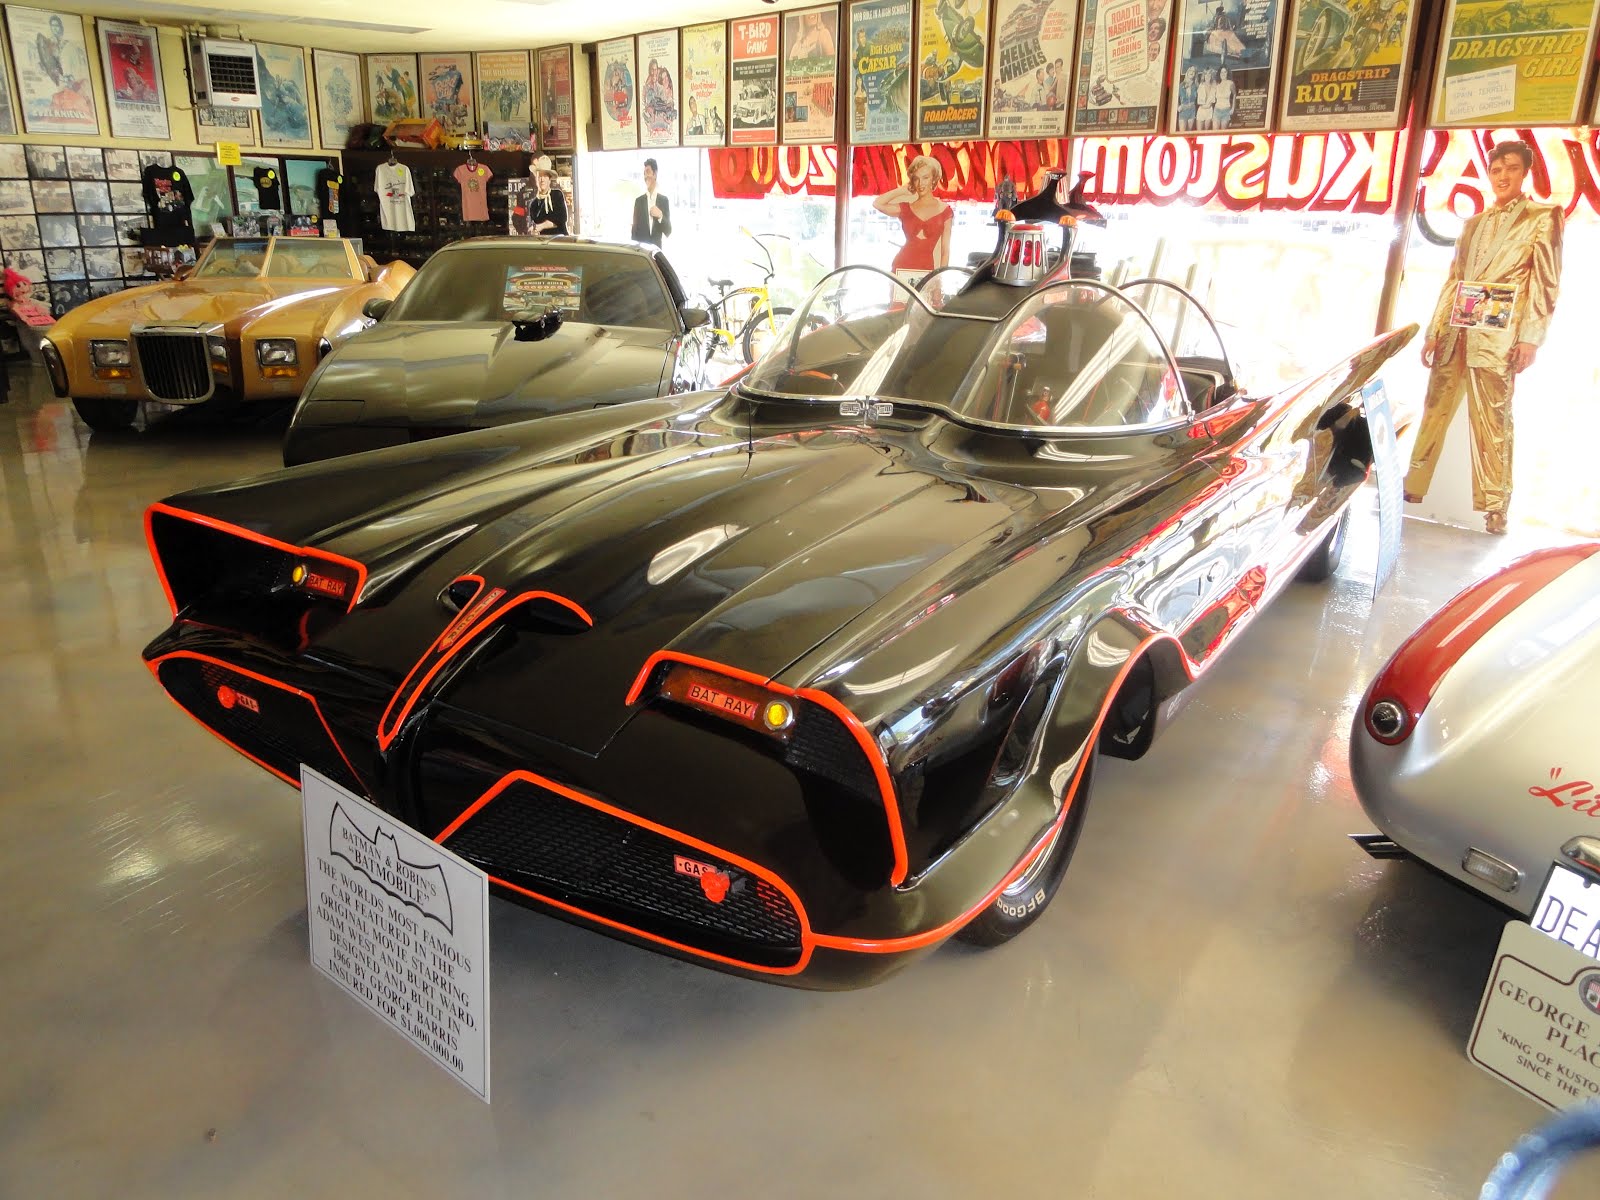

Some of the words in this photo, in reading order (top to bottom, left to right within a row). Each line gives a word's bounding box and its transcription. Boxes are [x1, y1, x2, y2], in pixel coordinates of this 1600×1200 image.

[1108, 14, 1145, 38] NASHVILLE
[1111, 6, 1131, 24] ROAD
[1132, 4, 1141, 15] TO
[746, 40, 768, 54] GANG
[870, 44, 882, 56] HIGH
[883, 41, 904, 54] SCHOOL
[1000, 41, 1033, 67] HELL
[1112, 40, 1142, 58] ROBBINS
[1117, 36, 1136, 46] MARTY
[1448, 33, 1587, 60] DRAGSTRIP
[858, 55, 897, 74] CAESAR
[1000, 51, 1048, 84] WHEELS
[1310, 67, 1390, 83] DRAGSTRIP
[1522, 55, 1580, 78] GIRL
[1294, 82, 1358, 103] RIOT
[310, 575, 324, 587] BAT
[327, 580, 343, 594] RAY
[690, 685, 720, 704] BAT
[724, 697, 752, 715] RAY
[342, 827, 382, 860] BATMAN
[385, 855, 392, 868] &
[317, 857, 338, 880] THE
[341, 872, 384, 912] WORLDS
[388, 905, 418, 936] MOST
[423, 928, 471, 973] FAMOUS
[332, 884, 351, 906] CAR
[355, 899, 410, 947] FEATURED
[414, 940, 427, 959] IN
[431, 951, 455, 980] THE
[316, 905, 344, 933] ADAM
[348, 926, 376, 956] WEST
[380, 950, 403, 975] AND
[407, 970, 436, 999] BURT
[321, 892, 369, 935] ORIGINAL
[373, 928, 407, 963] MOVIE
[412, 956, 470, 1007] STARRING
[329, 929, 380, 974] DESIGNED
[384, 970, 407, 995] AND
[411, 990, 443, 1022] BUILT
[448, 1017, 461, 1035] IN
[329, 959, 373, 1001] INSURED
[377, 995, 397, 1021] FOR
[333, 947, 351, 968] 1966
[354, 963, 366, 980] BY
[370, 975, 413, 1017] GEORGE
[417, 1010, 458, 1051] BARRIS
[1498, 979, 1590, 1039] GEORGE
[1516, 1055, 1552, 1081] SINCE
[1556, 1078, 1581, 1097] THE
[1536, 1052, 1554, 1066] OF
[1556, 1063, 1600, 1095] KUSTO
